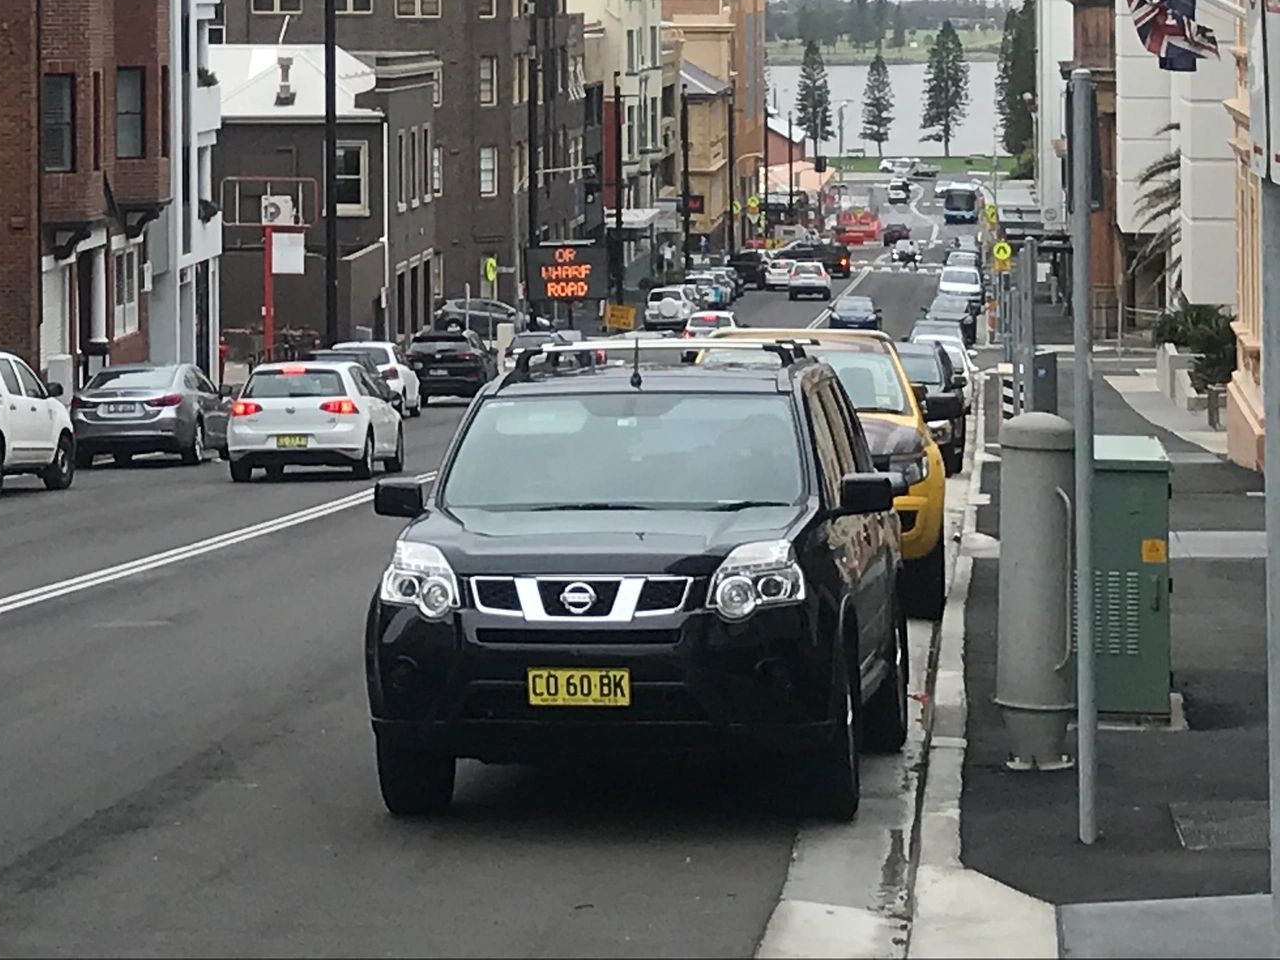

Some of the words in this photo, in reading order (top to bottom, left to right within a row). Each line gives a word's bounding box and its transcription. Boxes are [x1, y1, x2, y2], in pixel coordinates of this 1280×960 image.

[555, 248, 577, 262] OR
[541, 264, 592, 279] WHARF
[547, 282, 588, 297] ROAD
[566, 674, 592, 697] 60
[599, 674, 626, 697] BK
